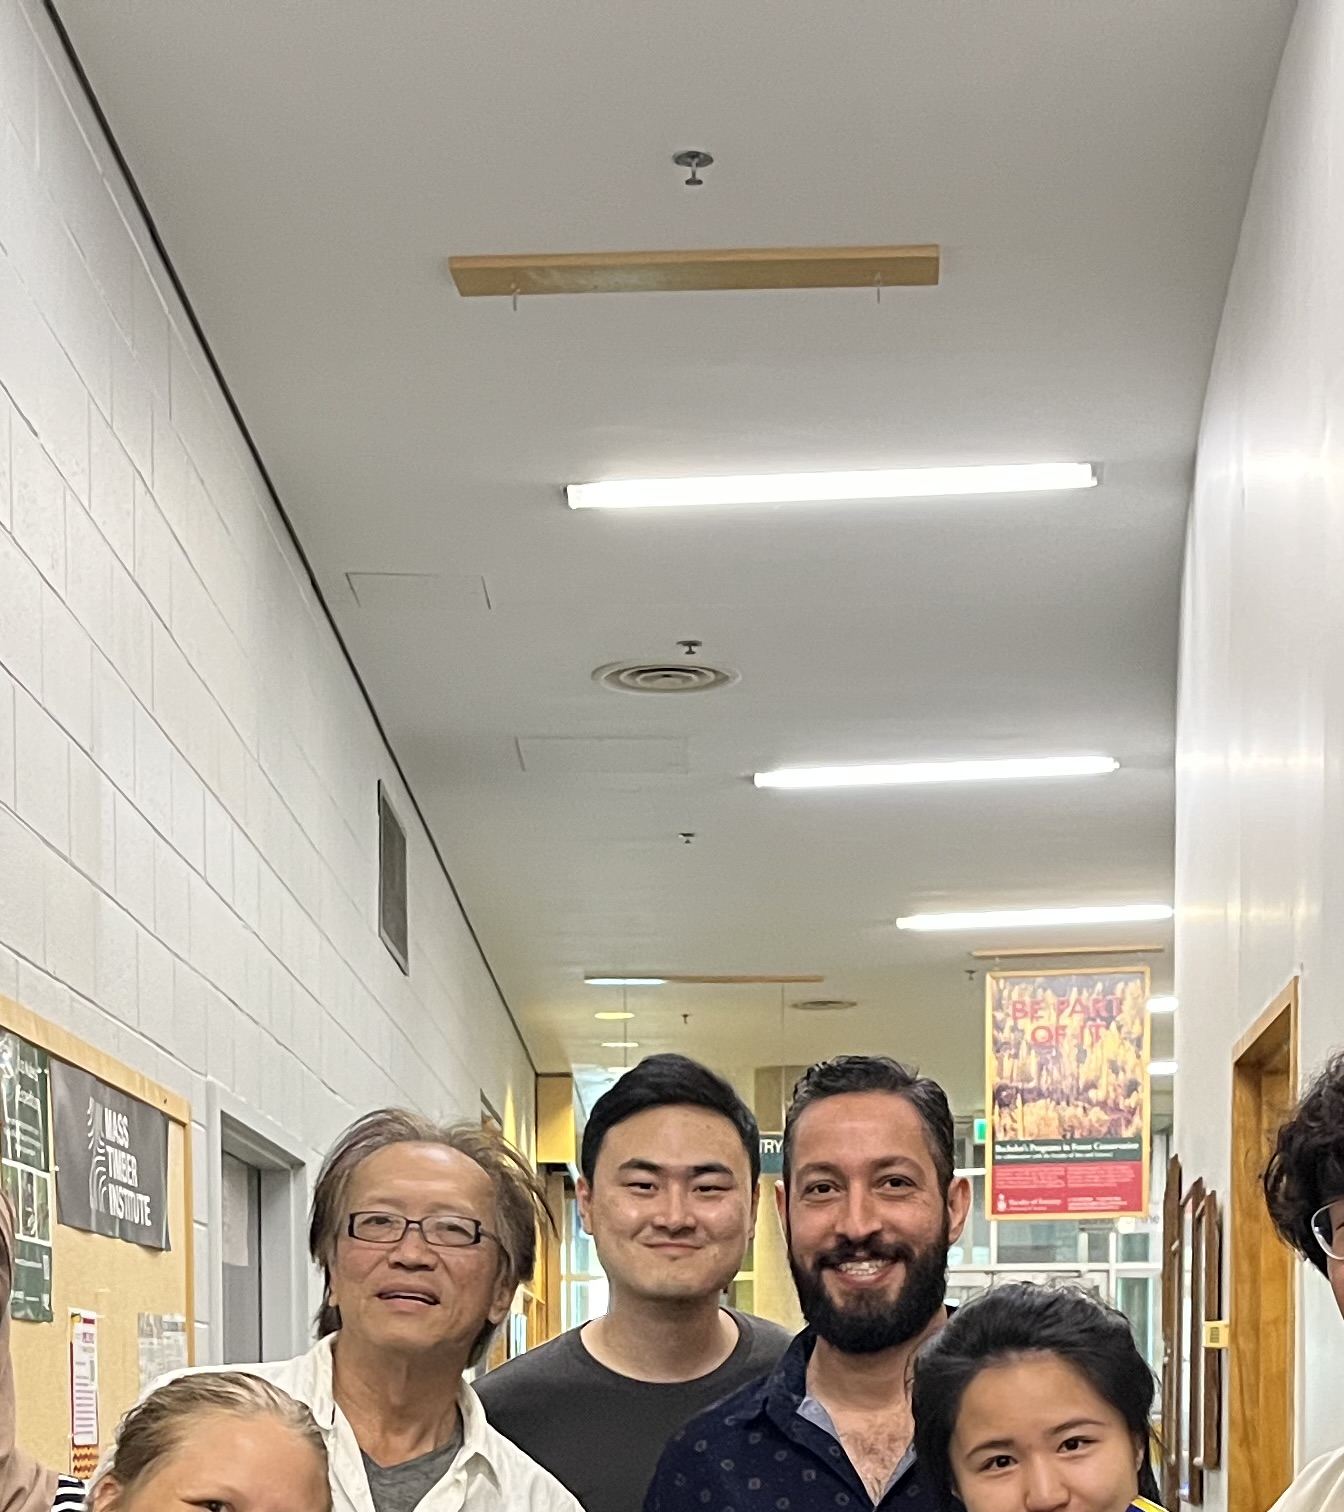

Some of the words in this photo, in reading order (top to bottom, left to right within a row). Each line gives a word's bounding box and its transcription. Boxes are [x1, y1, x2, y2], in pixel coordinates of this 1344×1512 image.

[1012, 1000, 1045, 1022] BE
[1055, 995, 1121, 1017] PART
[1031, 1024, 1067, 1046] OF
[1080, 1021, 1106, 1045] IT
[104, 1107, 130, 1149] MASS
[106, 1145, 139, 1188] TIMBER
[108, 1183, 152, 1227] INSTITUTE
